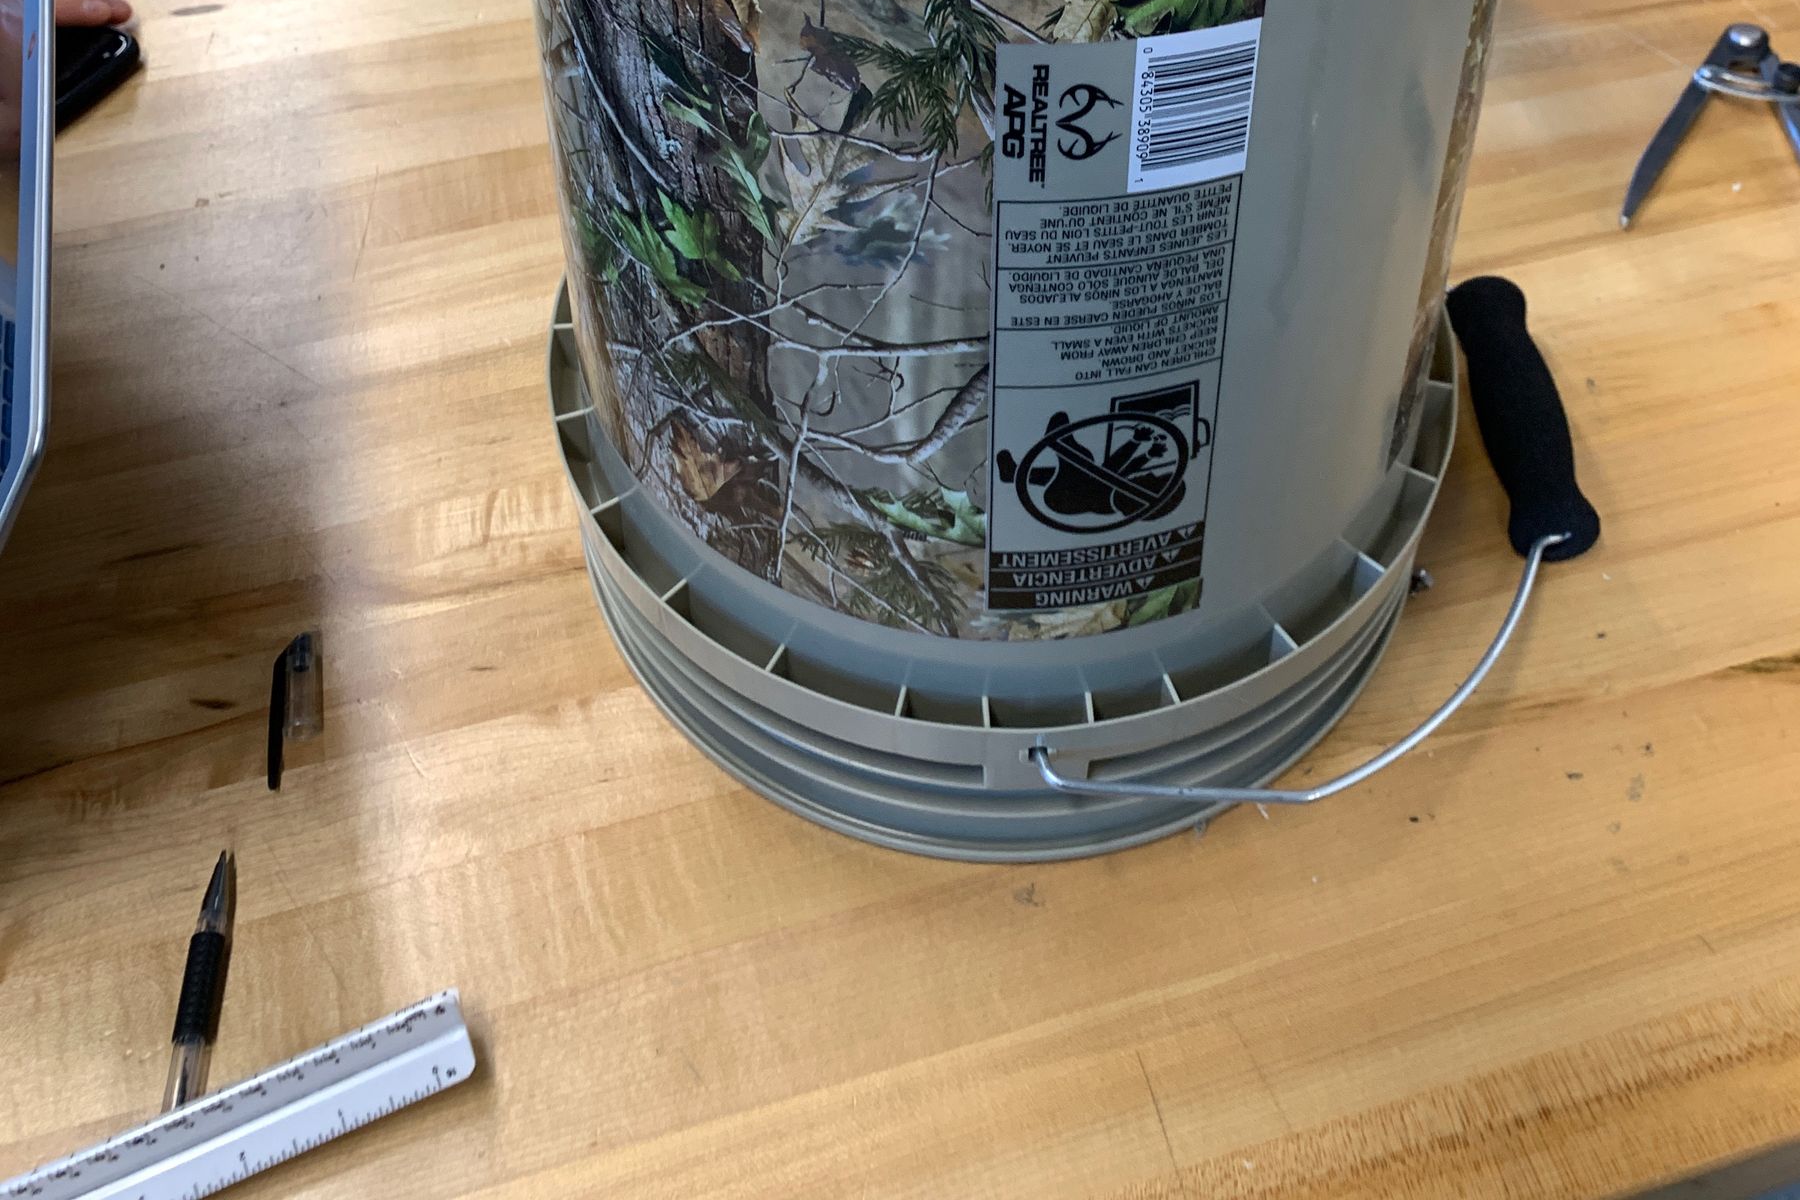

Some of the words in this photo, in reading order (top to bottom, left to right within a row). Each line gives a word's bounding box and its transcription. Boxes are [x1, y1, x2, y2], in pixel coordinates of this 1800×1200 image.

[1139, 71, 1155, 113] 84305
[1002, 83, 1027, 160] APG
[1029, 64, 1050, 183] REALTREE
[1136, 119, 1152, 160] 38909
[1194, 182, 1233, 200] PETITE
[1113, 201, 1129, 213] DE
[1133, 192, 1190, 212] QUANTITÉ
[1173, 202, 1193, 215] S'IL
[1058, 204, 1109, 217] LIQUIDE.
[1152, 208, 1168, 219] NE
[1197, 205, 1229, 221] TENIR
[1040, 217, 1085, 229] QU'UNE
[1089, 210, 1148, 227] CONTIENT
[1172, 214, 1193, 227] LES
[1062, 228, 1090, 240] LOIN
[1093, 219, 1168, 238] TOUT-PETITS
[1180, 218, 1228, 237] TOMBER
[1005, 230, 1037, 240] SEAU
[1041, 230, 1058, 240] DU
[1128, 235, 1141, 247] LE
[1145, 229, 1177, 244] DANS
[1206, 228, 1227, 242] LES
[1008, 242, 1052, 253] NOYER.
[1055, 242, 1071, 252] SE
[1075, 241, 1089, 252] ET
[1093, 237, 1124, 250] SEAU
[1159, 235, 1203, 253] JEUNES
[1045, 251, 1099, 264] PEUVENT
[1103, 244, 1155, 261] ENFANTS
[1202, 246, 1225, 260] UNA
[1203, 256, 1224, 270] DEL
[1063, 270, 1079, 280] DE
[1083, 264, 1142, 280] CANTIDAD
[1161, 263, 1199, 279] BALDE
[1112, 272, 1159, 287] AUNQUE
[1160, 268, 1223, 290] MANTENGA
[1008, 282, 1073, 293] CONTENGA
[1124, 284, 1147, 296] LOS
[1150, 282, 1157, 292] A
[1185, 279, 1222, 297] BALDE
[1020, 292, 1081, 304] ALEJADOS
[1176, 290, 1183, 300] Y
[1199, 290, 1220, 303] LOS
[1063, 312, 1109, 325] CAERSE
[1112, 305, 1157, 320] PUEDEN
[1172, 305, 1219, 324] AMOUNT
[1010, 316, 1040, 327] ESTE
[1044, 316, 1060, 326] EN
[1154, 316, 1168, 328] OF
[1169, 315, 1218, 335] BUCKETS
[1138, 328, 1165, 341] WITH
[1190, 325, 1217, 340] KEEP
[1051, 339, 1090, 350] SMALL
[1094, 338, 1101, 347] A
[1105, 334, 1134, 346] EVEN
[1131, 333, 1186, 352] CHILDREN
[1175, 337, 1216, 355] BUCKET
[1060, 349, 1094, 360] FROM
[1098, 345, 1128, 357] AWAY
[1148, 348, 1171, 360] AND
[1161, 347, 1215, 368] CHILDREN
[1106, 366, 1131, 378] FALL
[1135, 361, 1157, 373] CAN
[1075, 370, 1101, 380] INTO
[998, 532, 1171, 568] AVERTISSEMENT
[1013, 550, 1157, 587] ADVERTENCIA
[1035, 581, 1132, 606] WARNING
